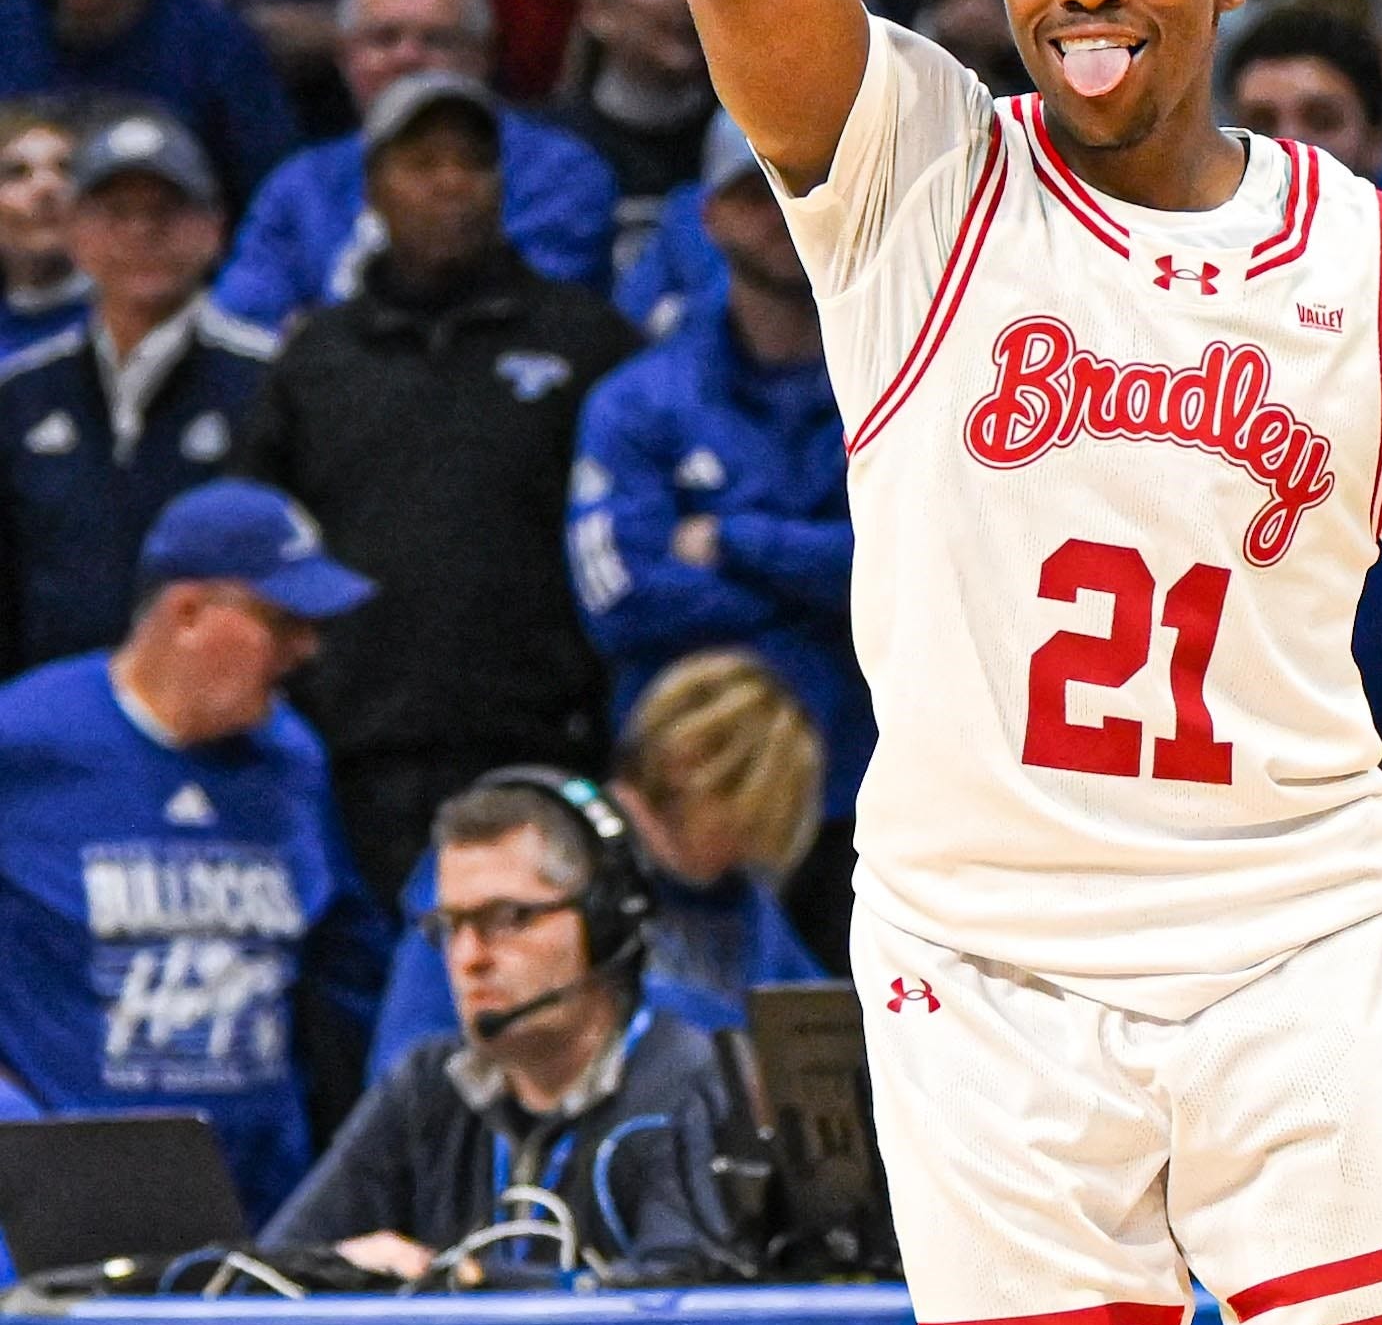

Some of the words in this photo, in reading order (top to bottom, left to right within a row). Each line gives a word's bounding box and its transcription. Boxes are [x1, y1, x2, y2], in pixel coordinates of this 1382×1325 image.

[1296, 302, 1344, 328] VALLEY
[964, 315, 1335, 568] Bradley
[1022, 538, 1234, 786] 21
